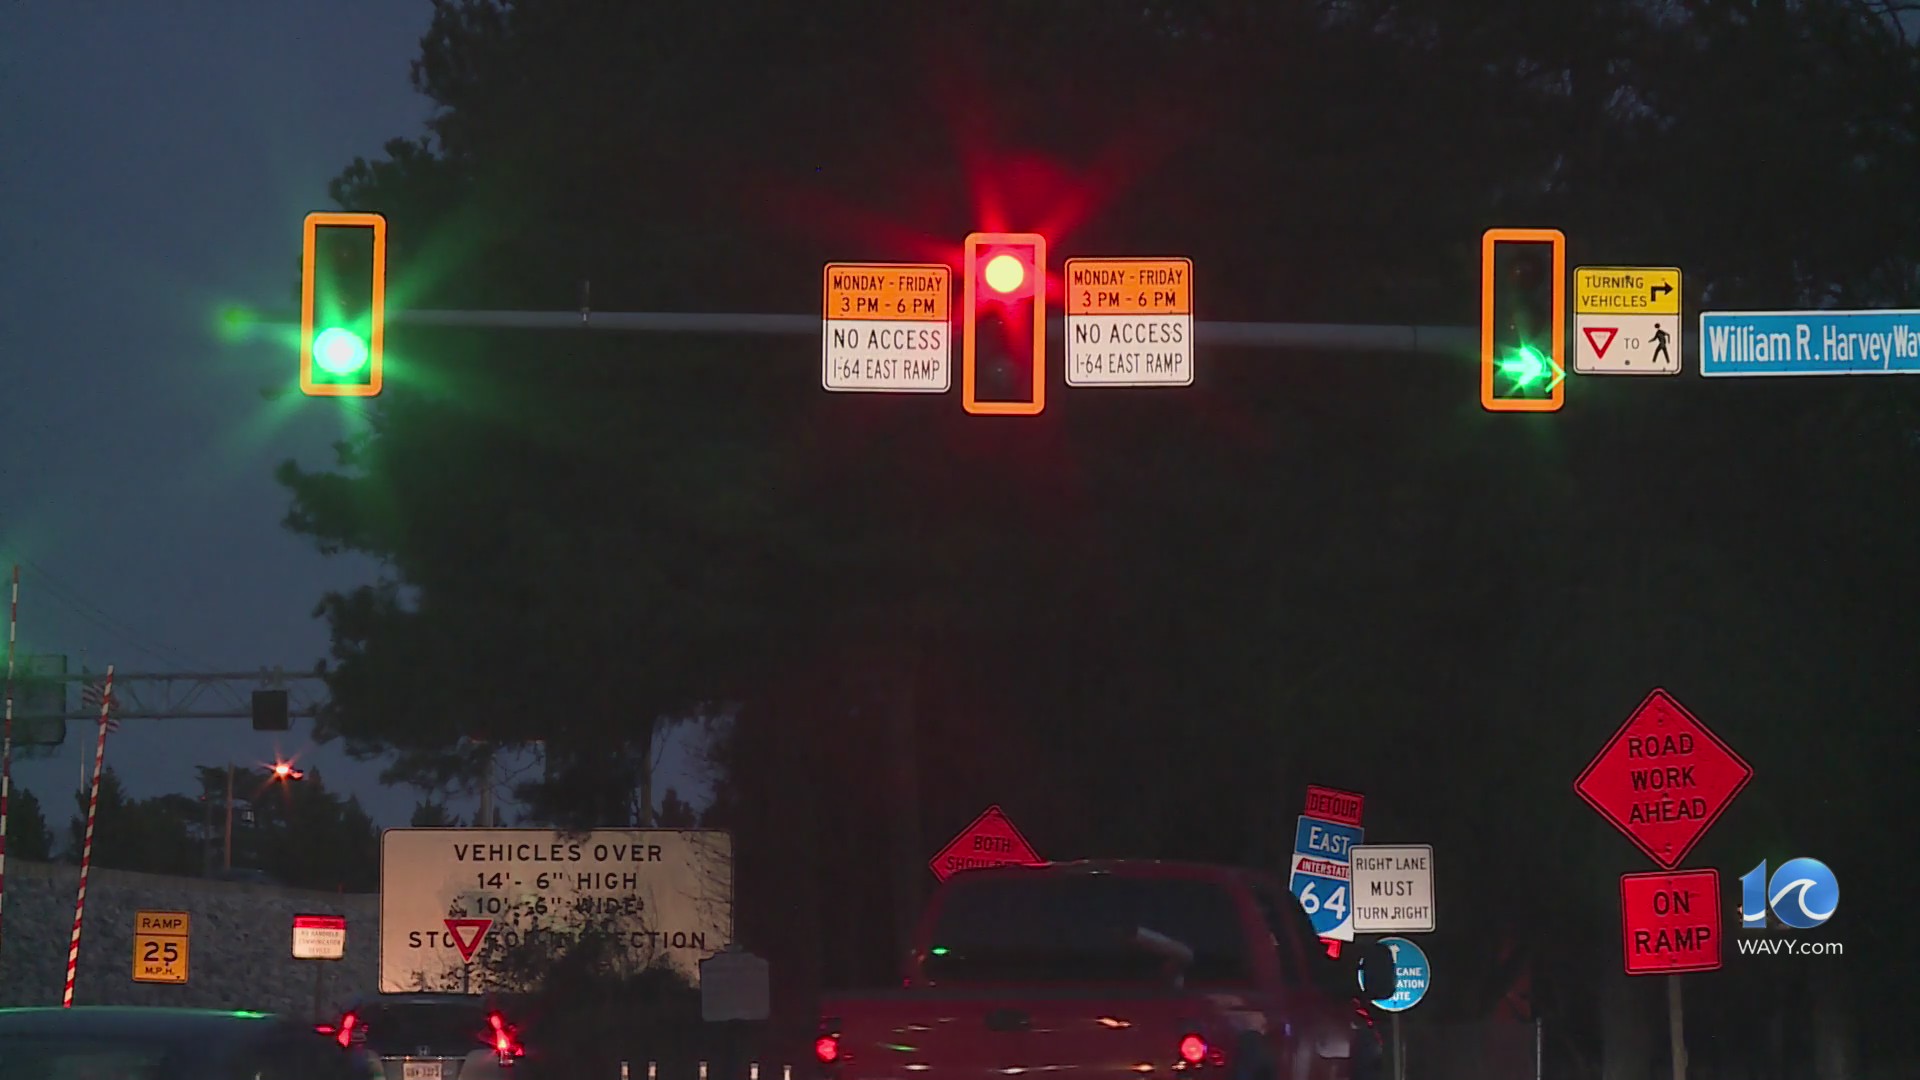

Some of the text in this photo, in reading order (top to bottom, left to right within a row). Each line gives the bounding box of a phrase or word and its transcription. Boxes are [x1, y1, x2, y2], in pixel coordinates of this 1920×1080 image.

[834, 276, 884, 291] MONDAY
[899, 276, 942, 291] FRIDAY
[1074, 270, 1125, 285] MONDAY
[1139, 269, 1183, 285] FRIDAY
[1585, 276, 1644, 289] TURNING
[842, 297, 850, 313] 3
[857, 298, 878, 313] PM
[897, 298, 906, 313] 6
[913, 298, 935, 313] PM
[1082, 291, 1091, 307] 3
[1097, 292, 1119, 307] PM
[1138, 292, 1147, 307] 6
[1153, 291, 1176, 307] PM
[1581, 295, 1648, 308] VEHICLES
[834, 328, 941, 350] NO ACCESS
[1075, 323, 1183, 344] NO ACCESS
[1624, 337, 1640, 350] TO
[1709, 323, 1920, 370] William R. Harvey Wa
[834, 359, 940, 380] I-64 EAST RAMP
[1075, 353, 1183, 374] I-64 EAST RAMP
[1628, 733, 1695, 758] ROAD
[1631, 764, 1696, 791] WORK
[1309, 793, 1358, 818] DETOUR
[1628, 798, 1708, 824] AHEAD
[975, 836, 1012, 854] BOTH
[1308, 825, 1351, 855] EAST
[454, 844, 663, 862] VEHICLES OVER
[1356, 857, 1427, 871] RIGHT LANE
[577, 873, 638, 890] HIGH
[1371, 881, 1414, 896] MUST
[576, 898, 636, 915] WIDE
[1299, 881, 1347, 920] 64
[1653, 890, 1690, 915] ON
[1357, 906, 1429, 920] TURN RIGHT
[142, 918, 182, 929] RAMP
[409, 931, 453, 948] STO
[615, 931, 706, 950] ECTION
[1634, 926, 1711, 955] RAMP
[143, 941, 178, 962] 25
[1396, 979, 1424, 988] ATION
